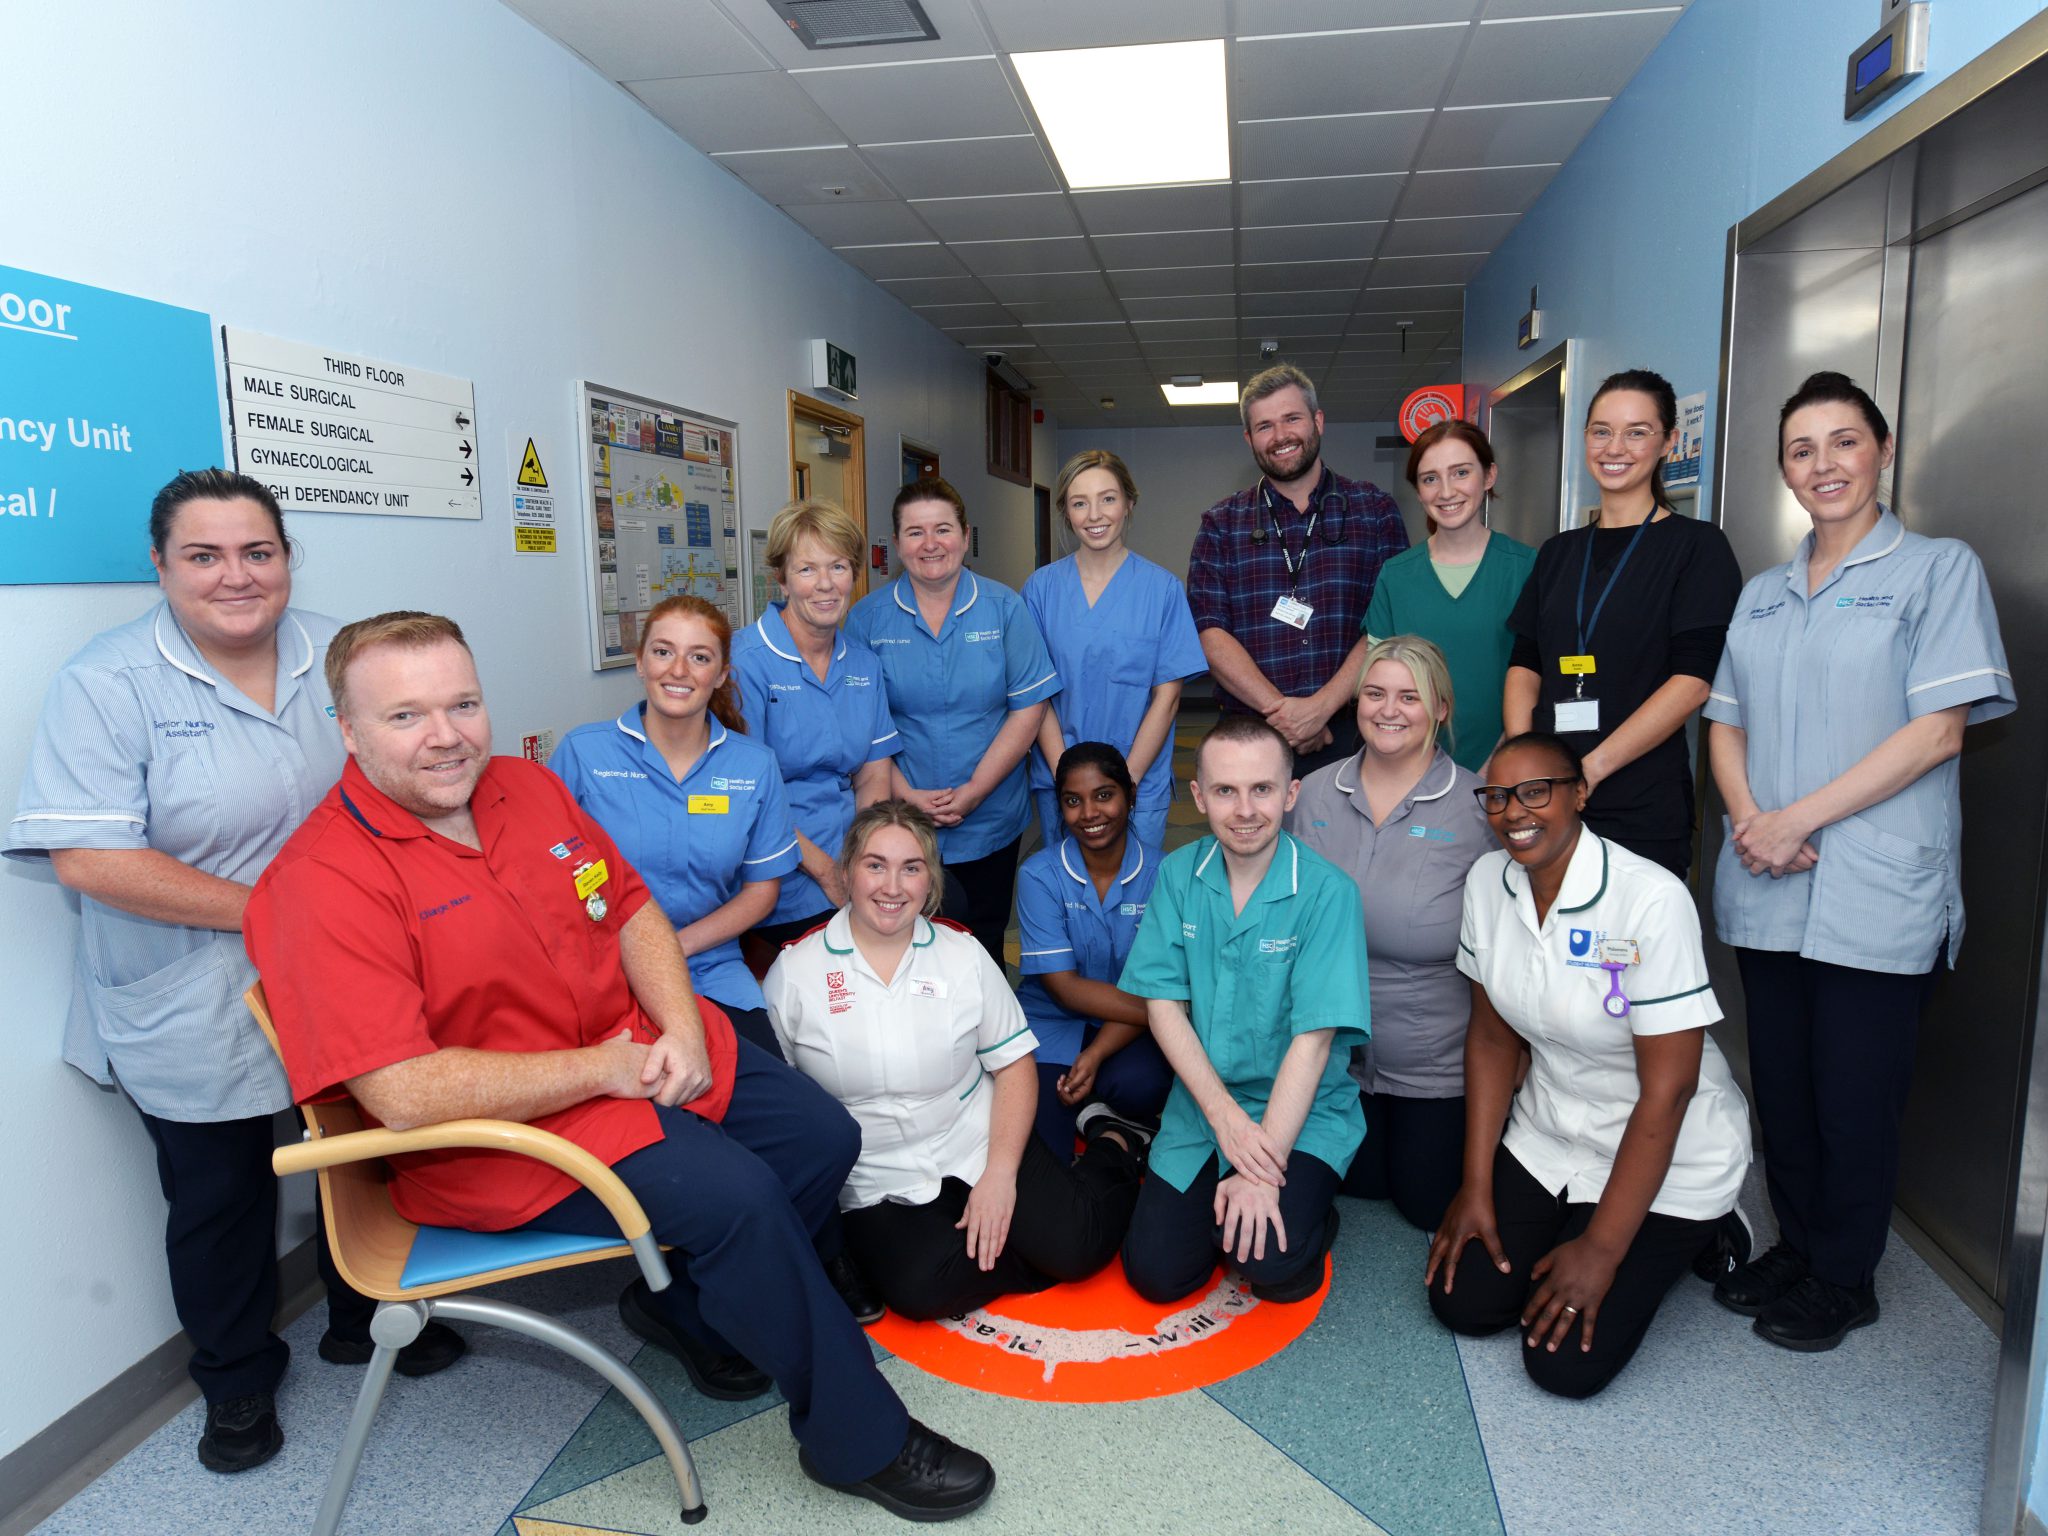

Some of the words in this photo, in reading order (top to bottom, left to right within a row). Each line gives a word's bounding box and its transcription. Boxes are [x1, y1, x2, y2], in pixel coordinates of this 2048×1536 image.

[323, 357, 361, 378] THIRD
[366, 366, 405, 387] FLOOR
[244, 376, 284, 397] MALE
[290, 384, 356, 409] SURGICAL
[67, 417, 132, 452] Unit
[248, 412, 304, 434] FEMALE
[311, 421, 374, 443] SURGICAL
[251, 448, 373, 474] GYNAECOLOGICAL
[296, 486, 379, 506] DEPENDANCY
[384, 493, 409, 507] UNIT
[153, 719, 180, 729] Senior
[165, 729, 209, 738] Assistant
[593, 768, 628, 778] Registered
[630, 771, 648, 779] Nurse
[419, 903, 449, 921] Charge
[946, 1312, 1042, 1354] plae
